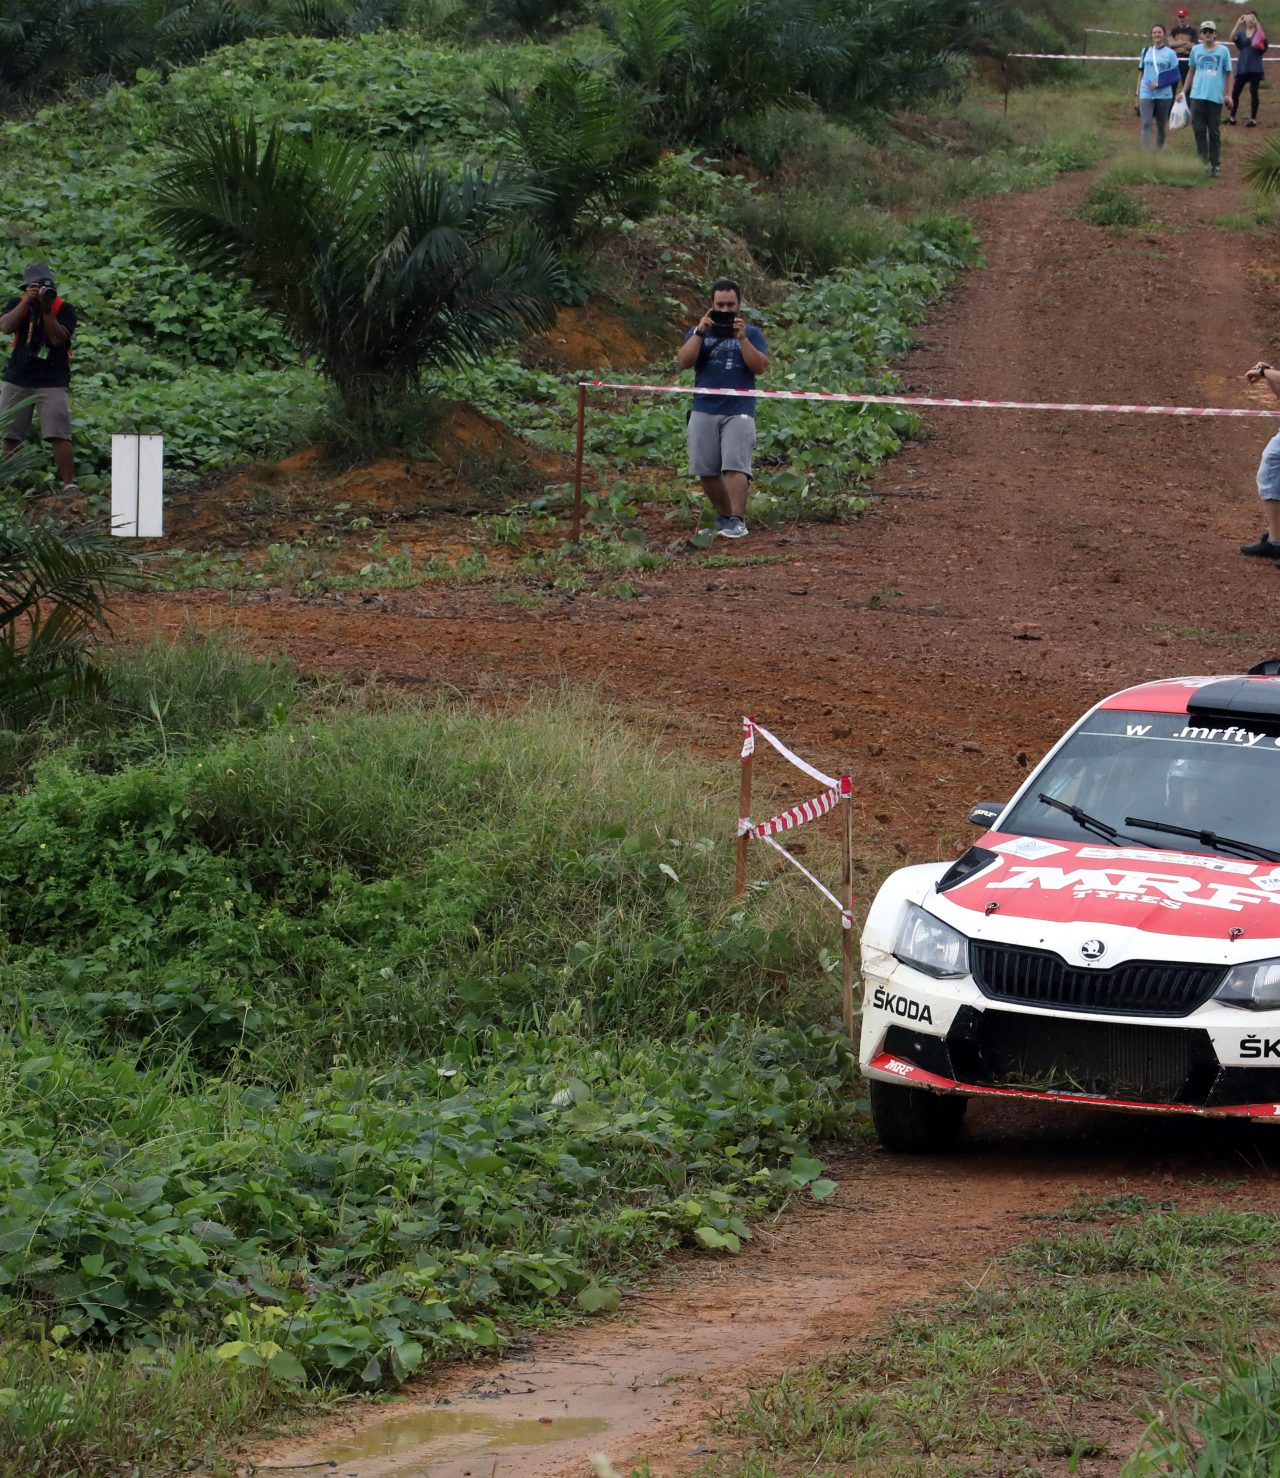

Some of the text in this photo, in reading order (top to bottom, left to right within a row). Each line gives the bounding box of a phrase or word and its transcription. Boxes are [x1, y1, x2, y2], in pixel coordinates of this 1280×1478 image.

[1073, 889, 1183, 910] TYRES
[873, 985, 933, 1025] ŠKODA
[884, 1060, 914, 1076] MRF
